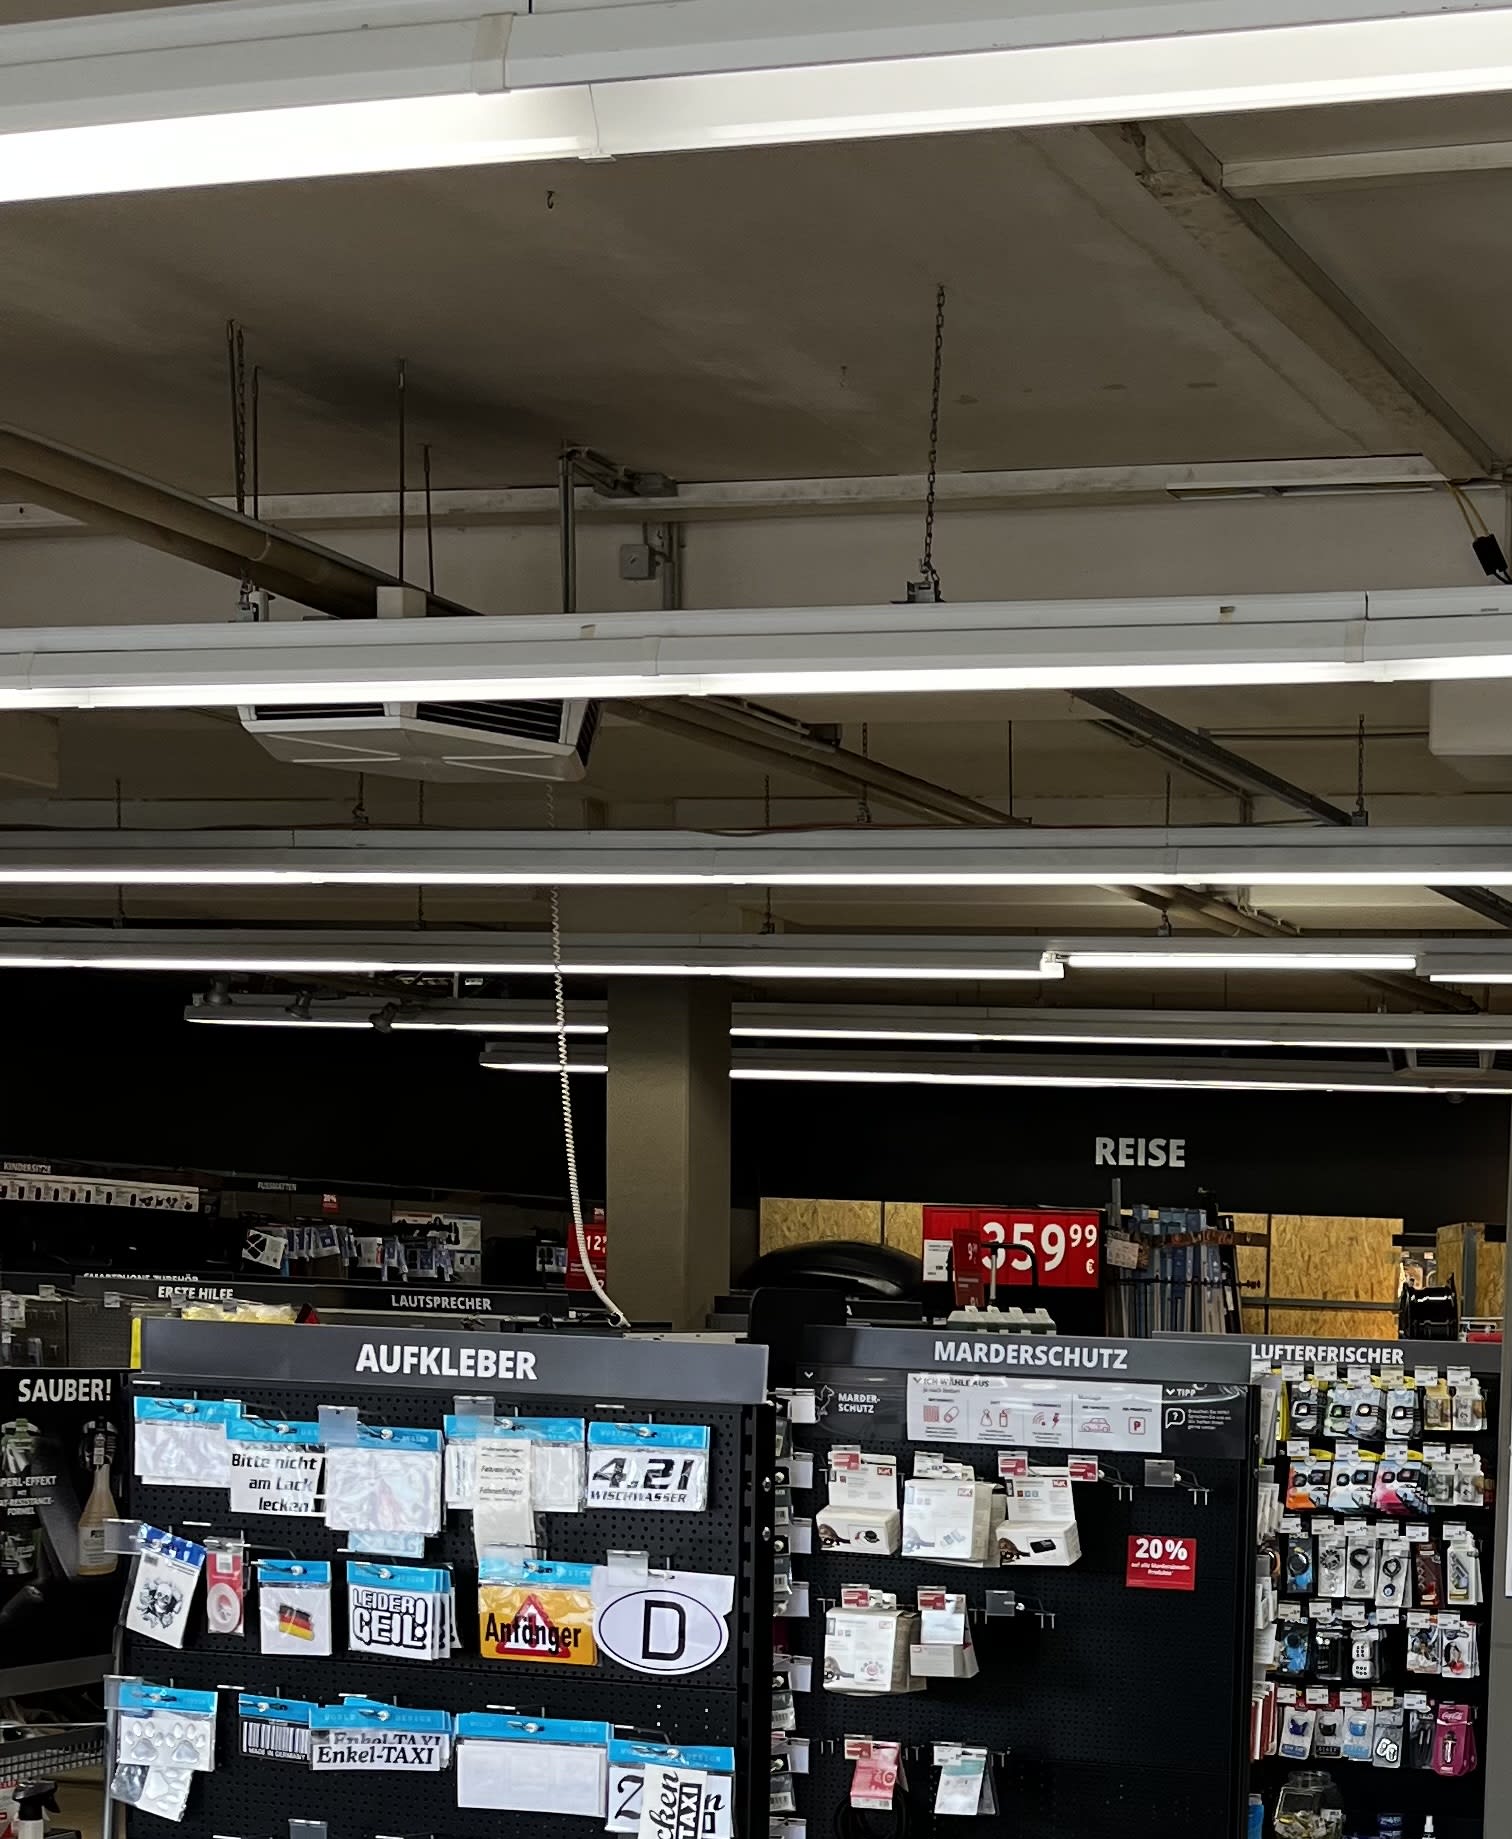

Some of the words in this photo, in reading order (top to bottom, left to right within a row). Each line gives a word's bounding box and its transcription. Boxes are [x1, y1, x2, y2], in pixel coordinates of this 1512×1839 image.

[1095, 1136, 1186, 1168] REISE
[1086, 1258, 1095, 1275] €
[158, 1286, 196, 1299] ERSTE
[199, 1288, 233, 1300] HILFE
[392, 1295, 492, 1311] LAUTSPRECHER
[355, 1344, 537, 1380] AUFKLEBER
[934, 1341, 1128, 1370] MARDERSCHUTZ
[1251, 1344, 1404, 1364] LUFTERFRISCHER
[18, 1378, 112, 1403] SAUBER!
[839, 1393, 880, 1404] MARDER-
[839, 1403, 875, 1414] SCHUTZ
[232, 1454, 270, 1467] Bitte
[276, 1456, 317, 1470] nicht
[249, 1479, 270, 1489] am
[276, 1477, 312, 1491] Lack
[259, 1497, 309, 1512] lecken
[591, 1491, 687, 1503] WISCHWASSER
[1135, 1538, 1187, 1560] 20%
[352, 1588, 416, 1615] LEIDER
[352, 1598, 428, 1649] GEIL!
[642, 1600, 686, 1661] D
[486, 1612, 582, 1655] Anfänger
[317, 1746, 434, 1764] Enkel-TAXI
